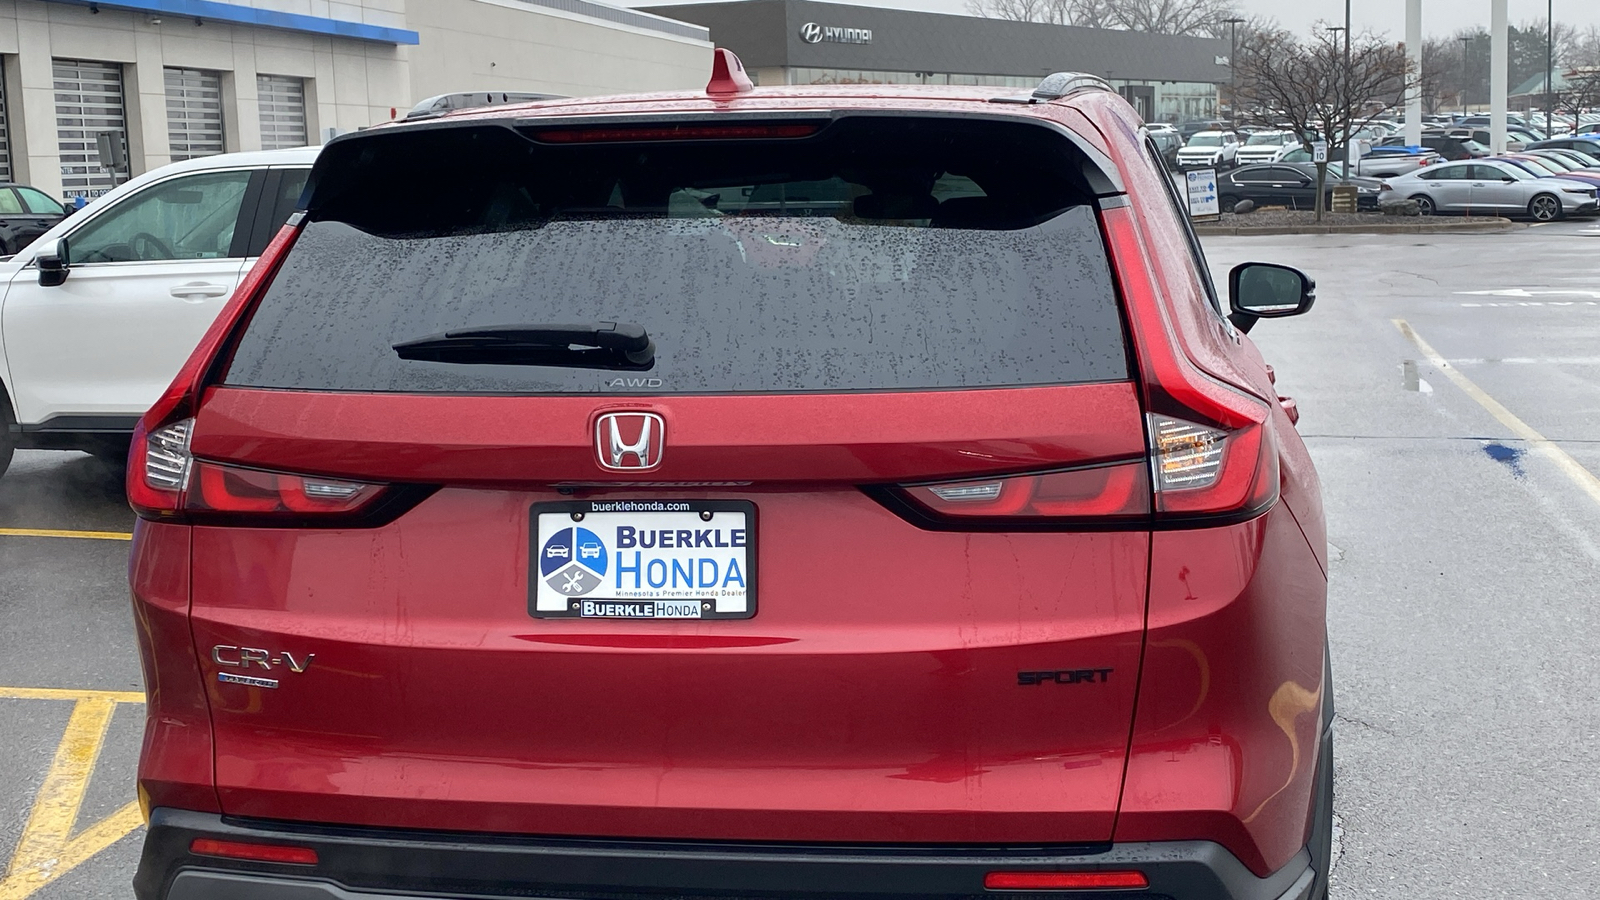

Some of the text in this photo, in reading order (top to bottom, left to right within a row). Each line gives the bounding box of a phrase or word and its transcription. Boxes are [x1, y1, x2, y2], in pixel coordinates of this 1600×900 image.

[825, 26, 872, 44] HYUNDAI
[1316, 152, 1324, 160] 10
[610, 378, 663, 388] AWD
[591, 501, 690, 512] buerklehonda.com
[616, 525, 746, 549] BUERKLE
[616, 551, 745, 589] HONDA
[695, 589, 719, 597] Honda
[722, 589, 747, 597] Dealer
[583, 602, 699, 617] BUERKLE HONDA
[212, 644, 316, 673] CR-V
[1017, 668, 1114, 686] SPORT
